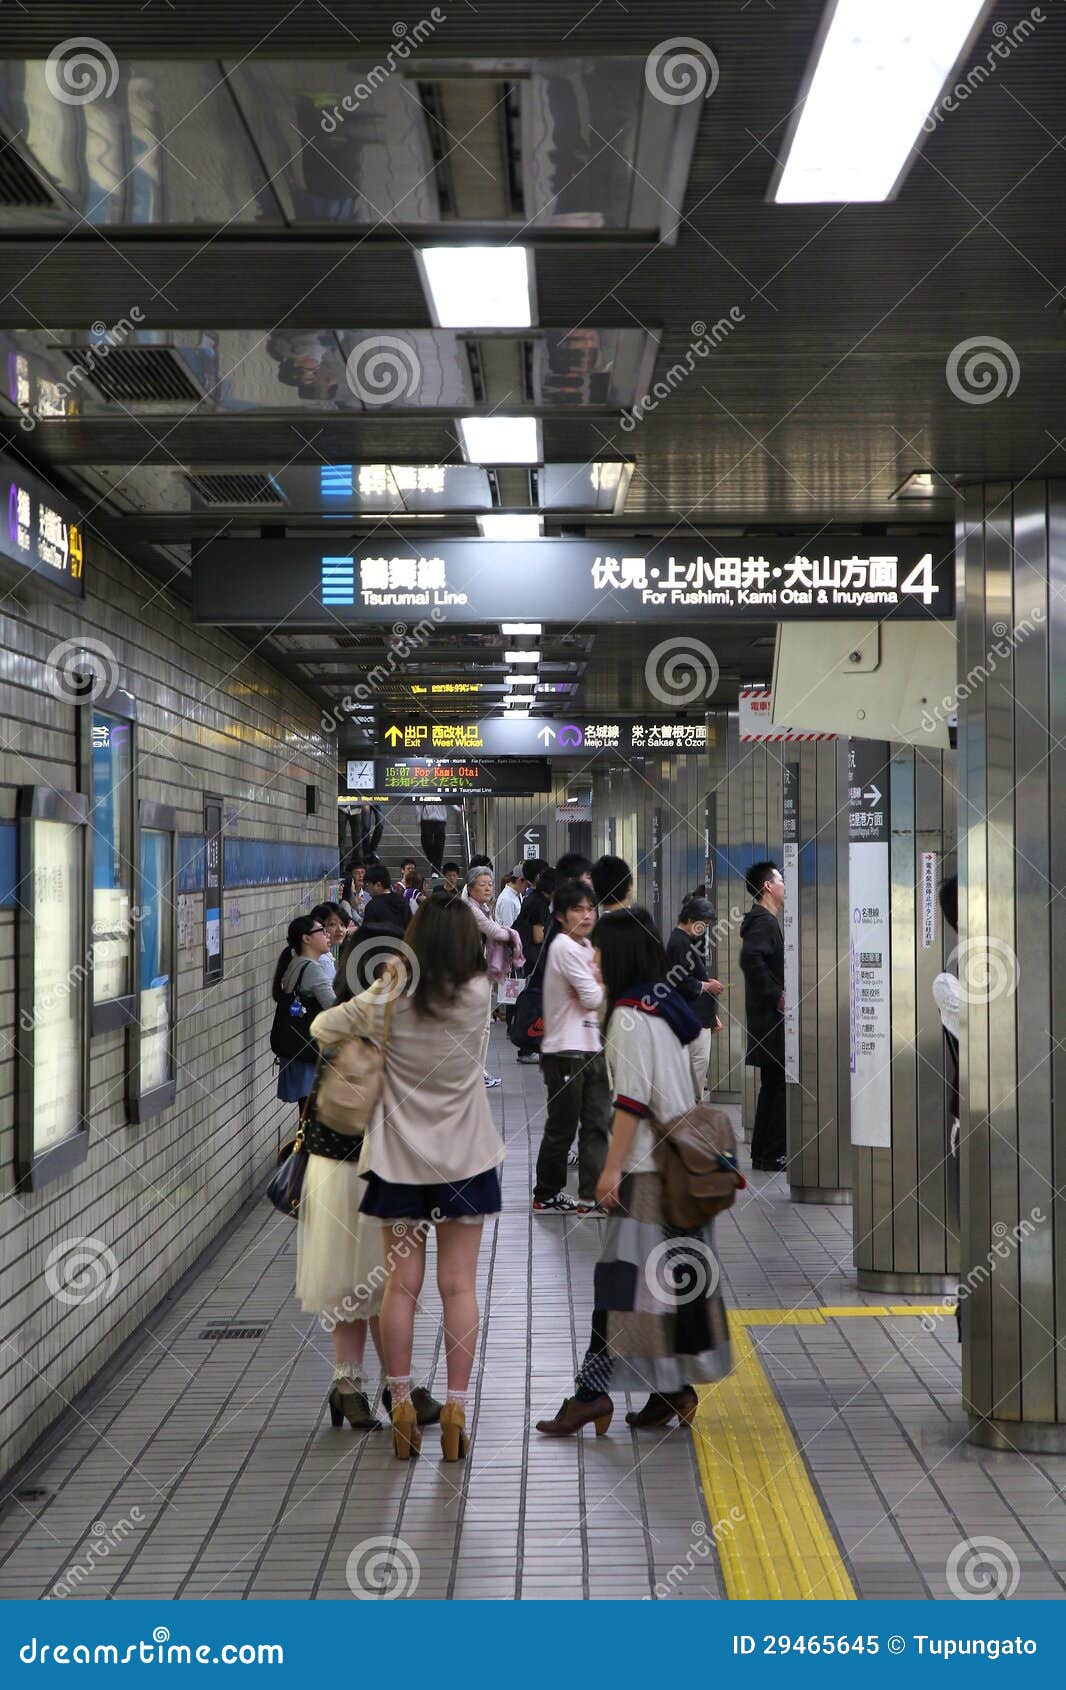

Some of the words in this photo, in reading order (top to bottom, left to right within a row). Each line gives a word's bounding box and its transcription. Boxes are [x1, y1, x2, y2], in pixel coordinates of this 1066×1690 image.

[900, 553, 940, 604] 4
[361, 591, 429, 605] Tsurumai
[434, 591, 468, 605] Line
[642, 590, 668, 604] For
[671, 590, 734, 606] Fushimi,
[738, 590, 776, 604] Kami
[780, 589, 812, 604] Otai
[817, 590, 829, 604] &
[833, 590, 898, 606] Inuyama
[751, 701, 770, 711] 電車
[404, 725, 428, 739] 出口
[432, 725, 478, 739] 西改札口
[584, 725, 620, 738] 名城線
[404, 738, 421, 747] Exit
[432, 738, 454, 747] West
[455, 738, 484, 747] Wicket
[604, 738, 619, 747] Line
[631, 738, 646, 747] For
[647, 738, 675, 747] Sakae
[676, 739, 683, 747] &
[386, 767, 409, 776] 15:07
[414, 767, 430, 776] For
[434, 767, 454, 776] Kami
[458, 767, 479, 776] Otai
